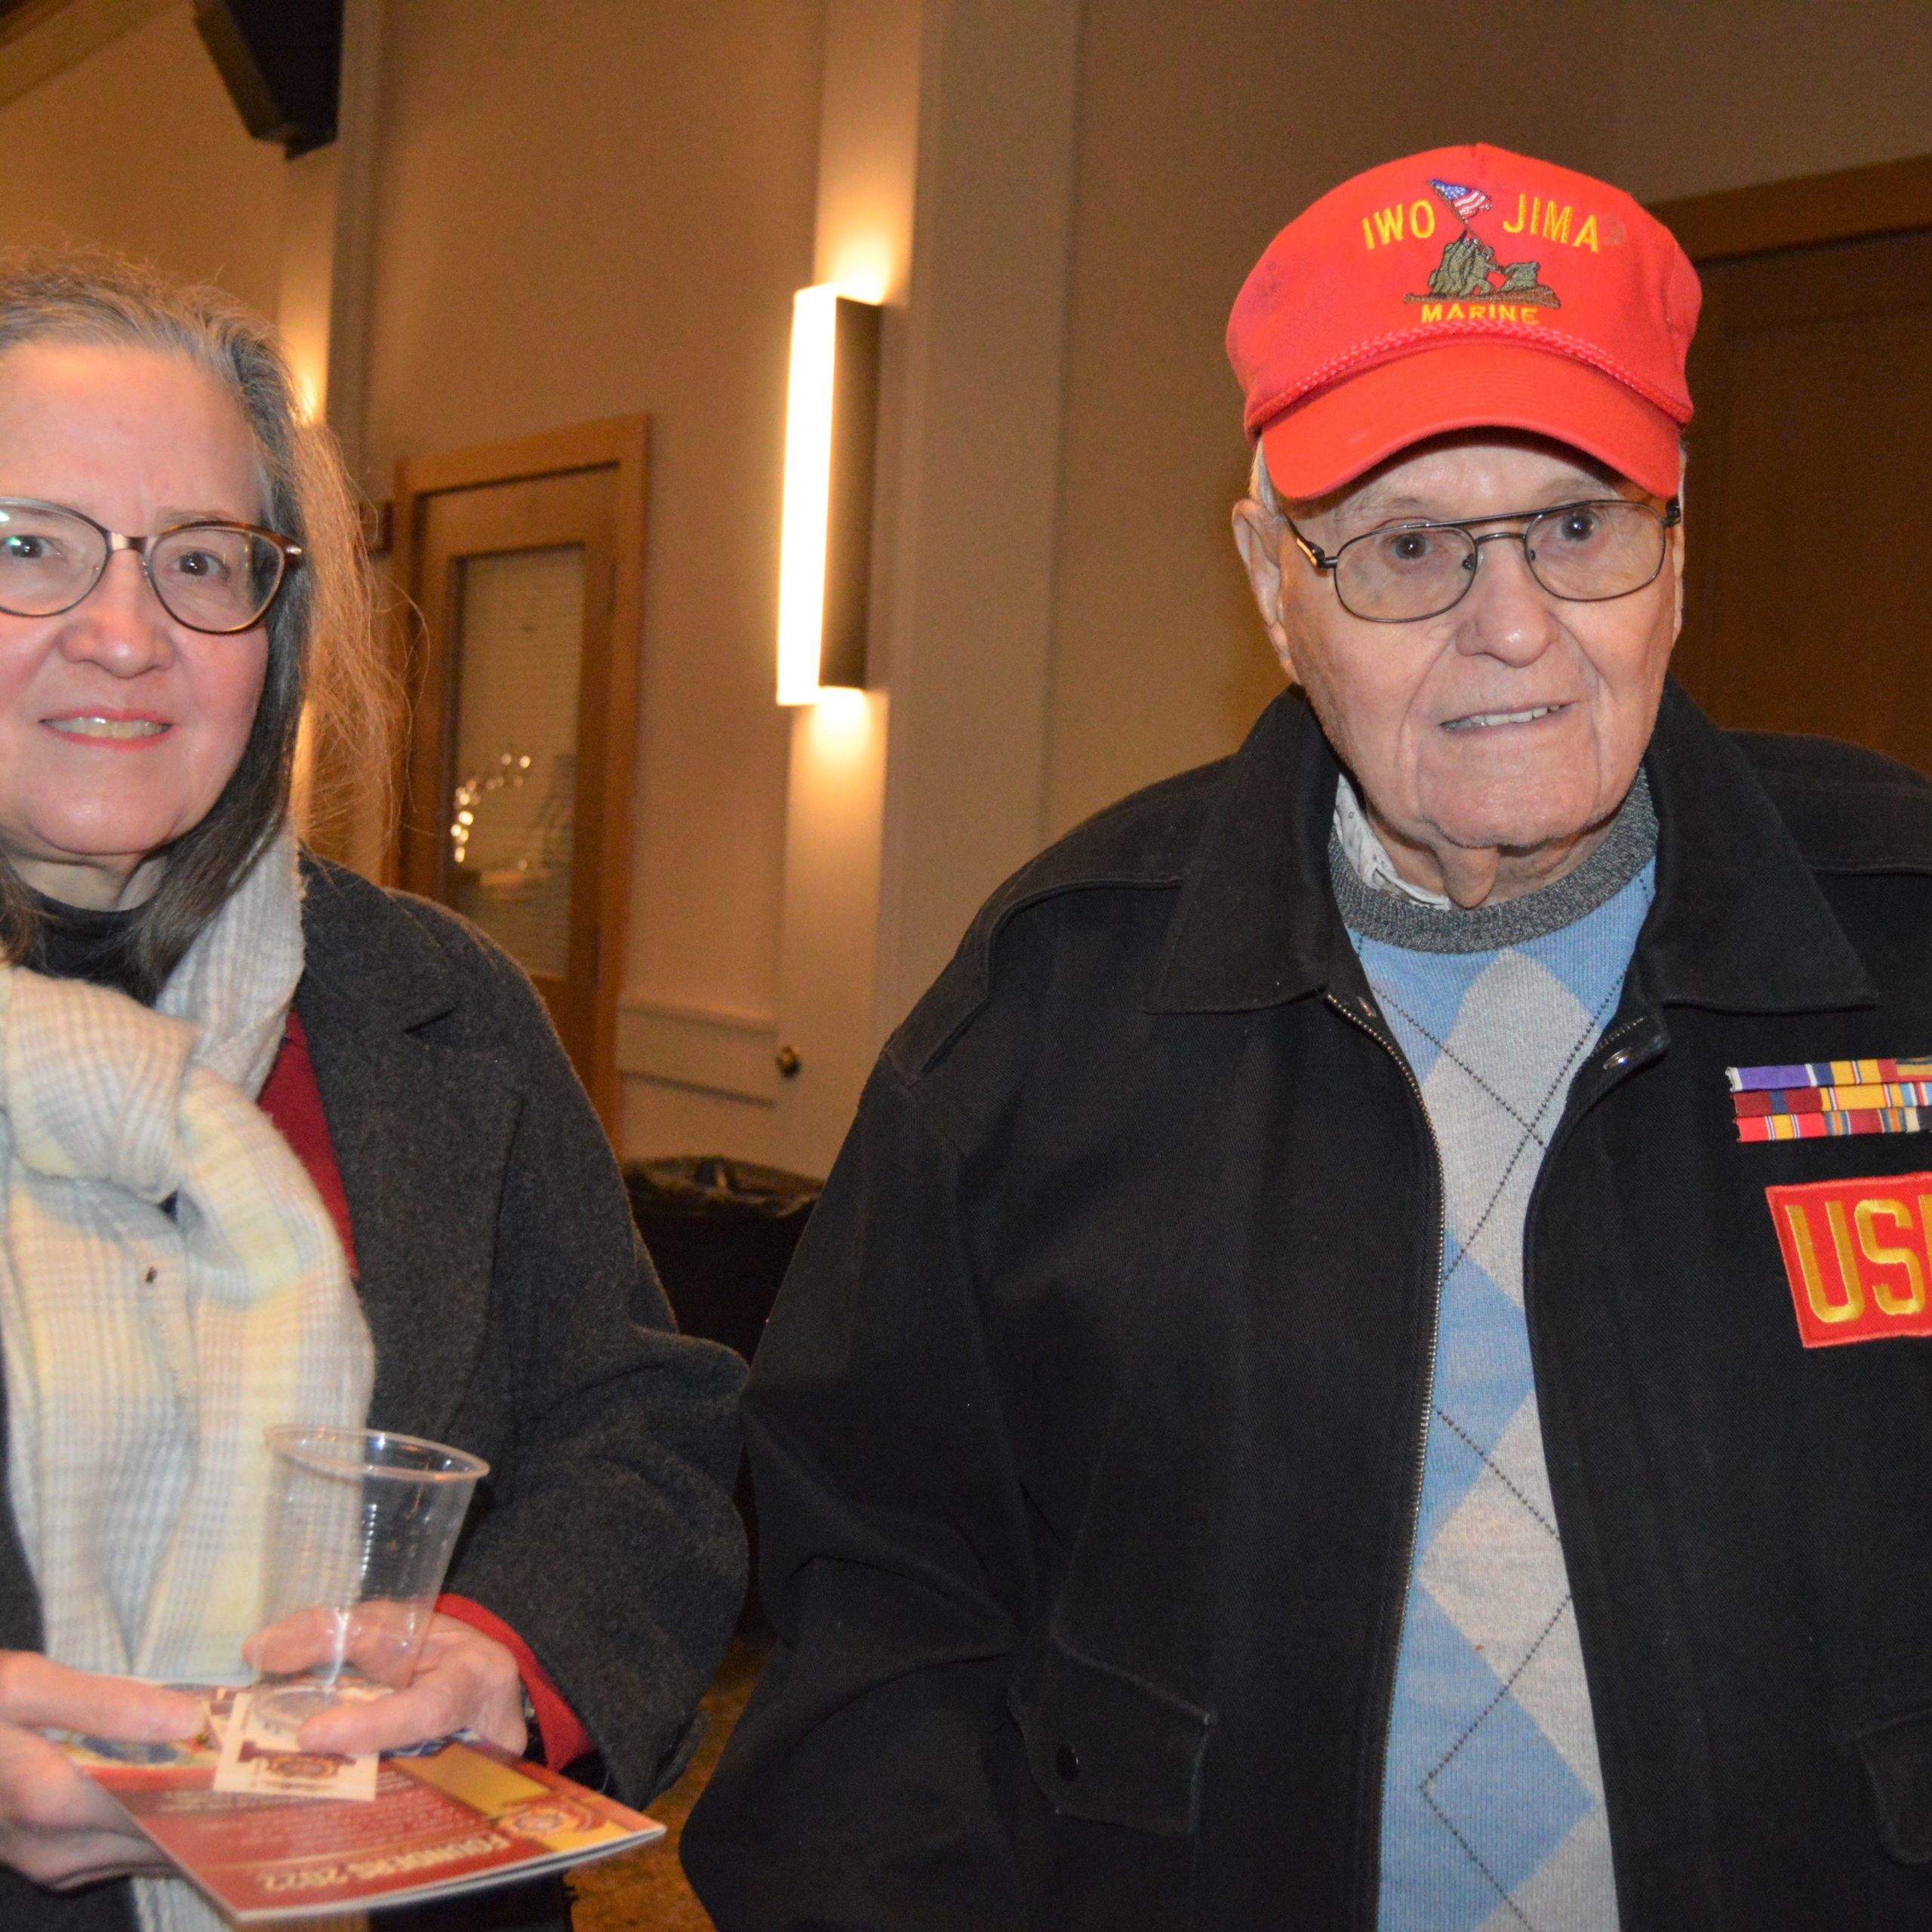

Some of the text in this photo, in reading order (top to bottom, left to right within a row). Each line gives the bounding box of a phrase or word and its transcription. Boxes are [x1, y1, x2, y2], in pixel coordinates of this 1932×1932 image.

[1361, 194, 1599, 253] IWO JIMA
[1421, 303, 1540, 325] MARINE
[1785, 1195, 1932, 1323] US
